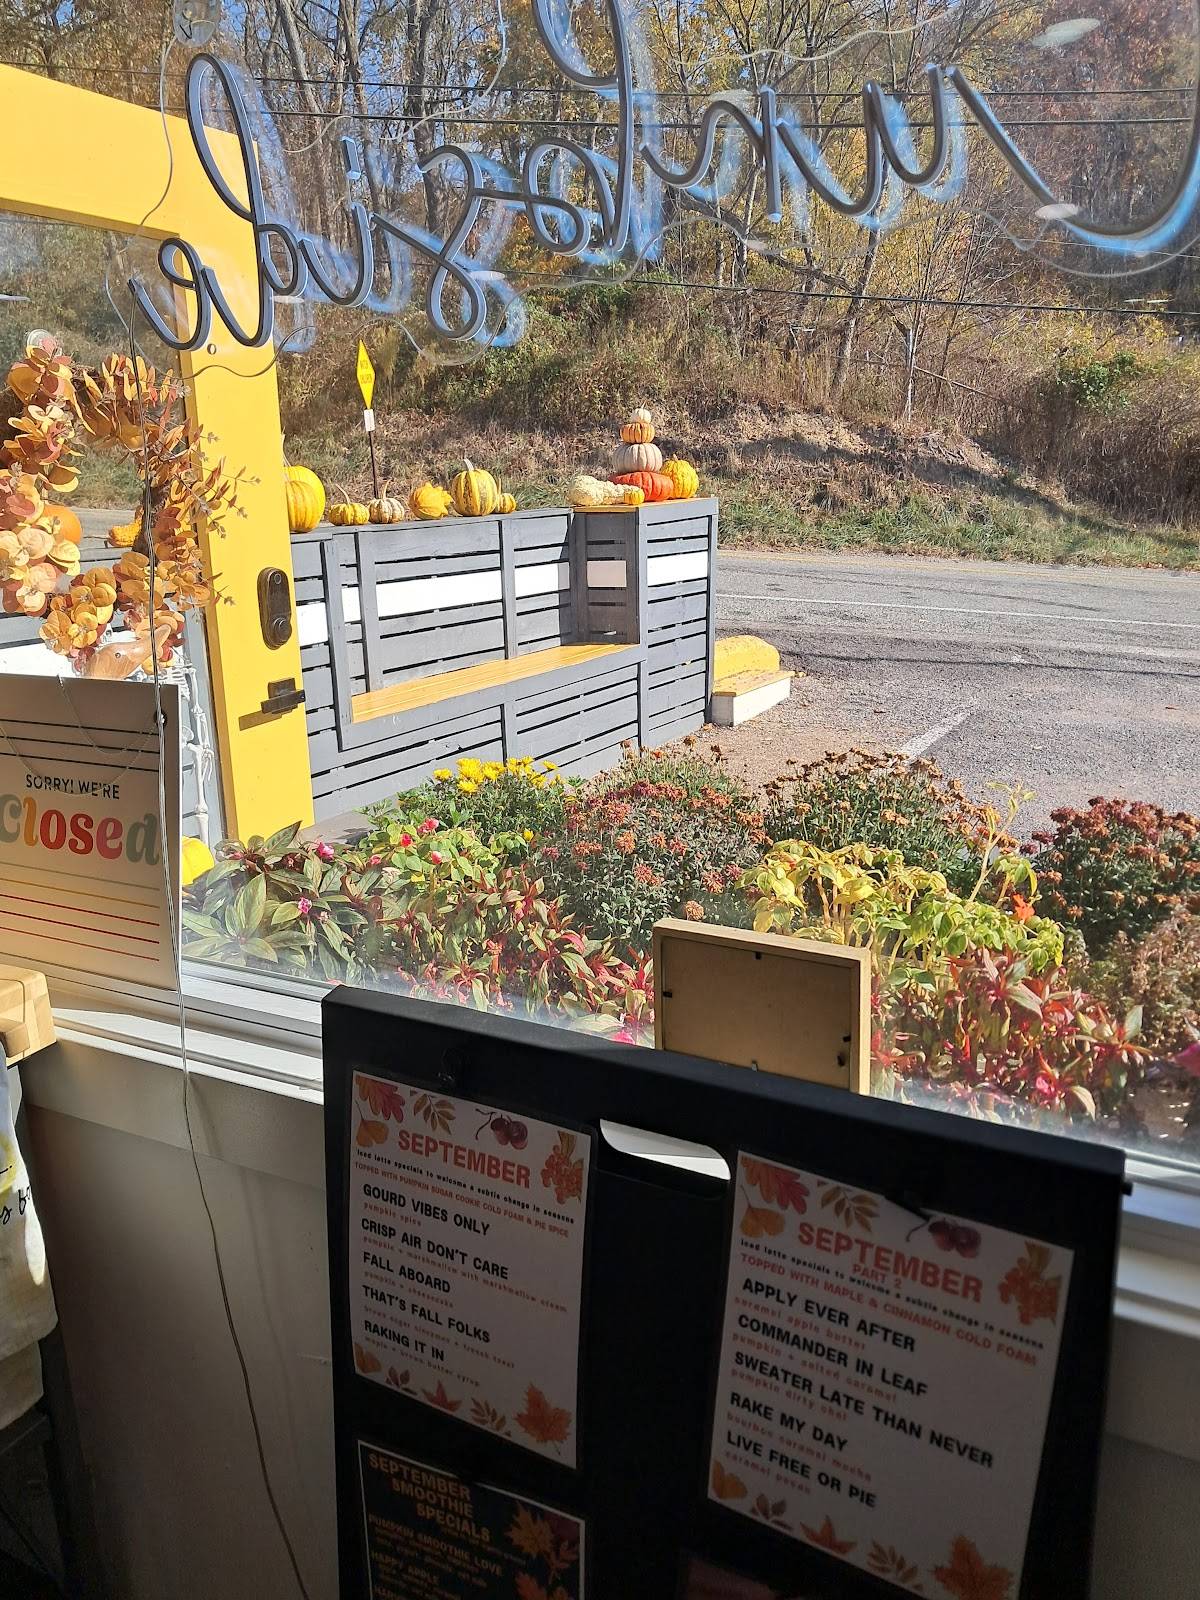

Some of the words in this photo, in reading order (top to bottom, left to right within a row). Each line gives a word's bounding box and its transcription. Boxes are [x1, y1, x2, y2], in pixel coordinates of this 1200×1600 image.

[26, 774, 74, 794] SORRY!
[78, 780, 120, 800] WE'RE
[398, 1129, 531, 1189] SEPTEMBER
[363, 1183, 406, 1208] GOURD
[412, 1198, 448, 1222] VIBES
[454, 1213, 490, 1236] ONLY
[483, 1202, 501, 1214] COLD
[361, 1218, 396, 1239] CRISP
[401, 1232, 422, 1249] AIR
[427, 1240, 468, 1265] DON'T
[473, 1257, 508, 1280] CARE
[363, 1251, 394, 1273] FALL
[399, 1265, 451, 1293] ABOARD
[798, 1221, 983, 1303] SEPTEMBER
[852, 1264, 887, 1284] PART
[894, 1278, 902, 1289] 2
[362, 1284, 406, 1311] THAT'S
[412, 1303, 443, 1325] FALL
[448, 1317, 490, 1343] FOLKS
[740, 1253, 786, 1276] TOPPED
[790, 1270, 819, 1288] WITH
[824, 1280, 864, 1304] MAPLE
[868, 1297, 878, 1308] &
[883, 1302, 951, 1335] CINNAMON
[956, 1328, 992, 1350] COLD
[996, 1343, 1038, 1366] FOAM
[742, 1278, 798, 1308] APPLY
[804, 1300, 850, 1328] EVER
[856, 1319, 916, 1353] AFTER
[364, 1320, 410, 1348] RAKING
[414, 1340, 426, 1354] IT
[432, 1346, 444, 1362] IN
[738, 1314, 849, 1368] COMMANDER
[855, 1358, 874, 1378] IN
[881, 1368, 929, 1397] LEAF
[730, 1392, 775, 1421] RAKE
[780, 1412, 806, 1434] MY
[812, 1426, 848, 1452] DAY
[734, 1351, 813, 1394] SWEATER
[820, 1384, 866, 1416] LATE
[872, 1405, 922, 1439] THAN
[929, 1430, 994, 1469] NEVER
[368, 1452, 472, 1501] SEPTEMBER
[391, 1477, 474, 1520] SMOOTHIE
[727, 1430, 763, 1458] LIVE
[768, 1449, 812, 1480] FREE
[817, 1472, 842, 1493] OR
[848, 1484, 878, 1508] PIE
[416, 1502, 492, 1544] SPECIALS
